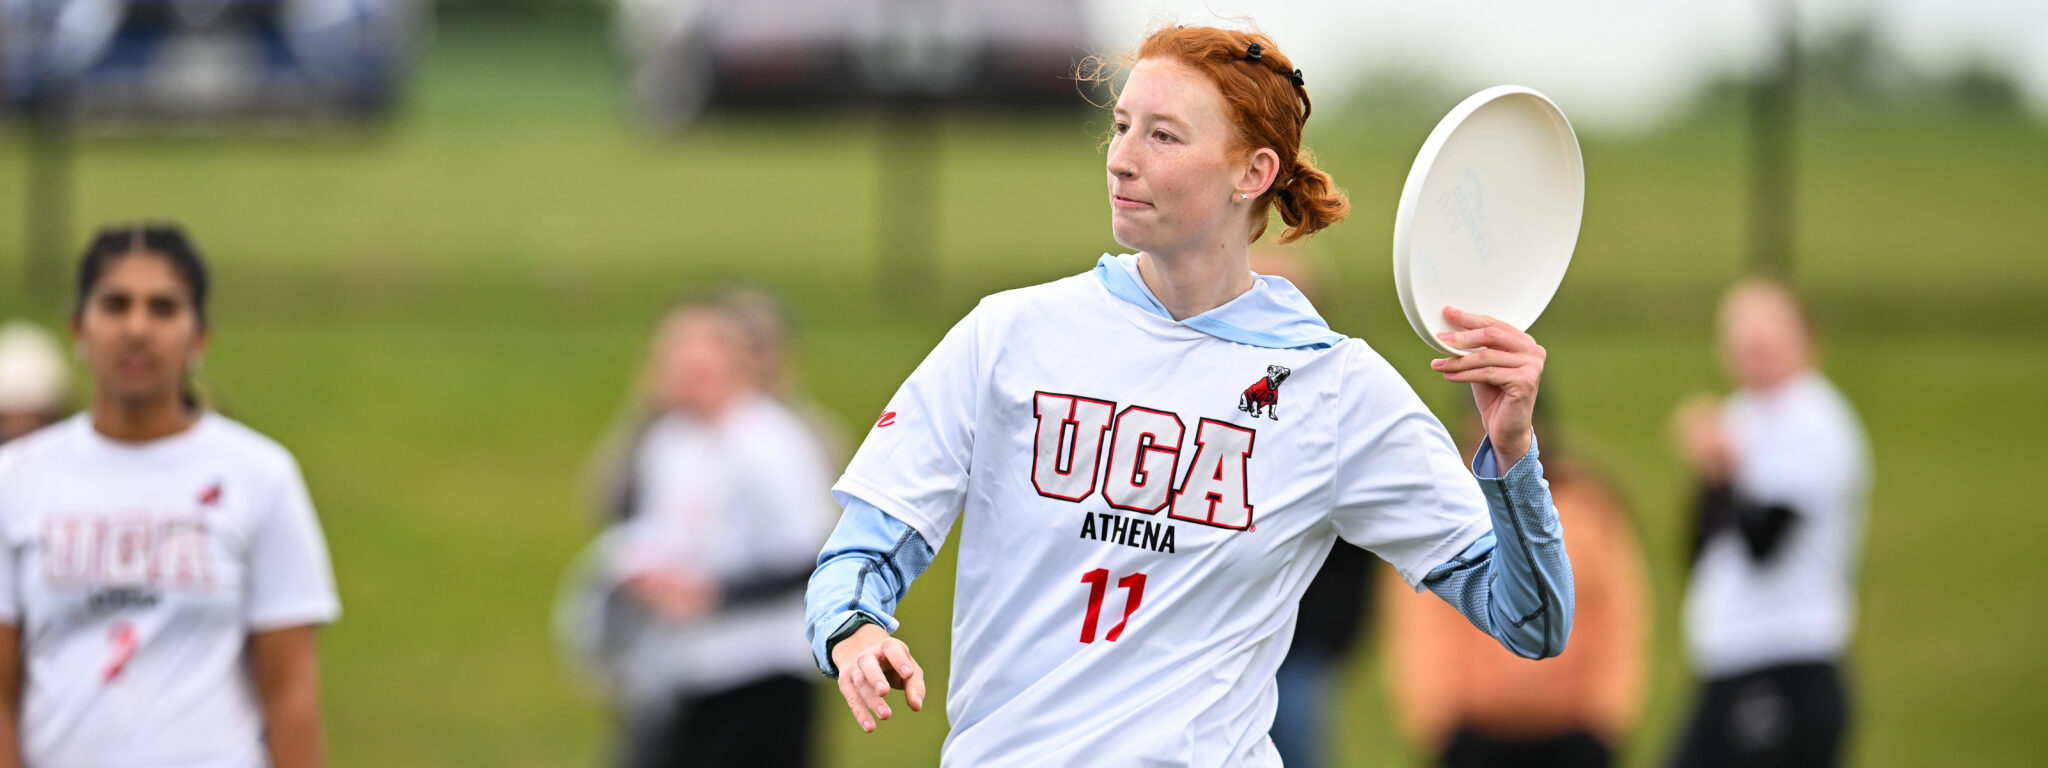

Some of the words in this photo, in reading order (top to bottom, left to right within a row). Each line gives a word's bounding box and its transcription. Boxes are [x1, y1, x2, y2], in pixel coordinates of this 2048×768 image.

[1031, 391, 1255, 531] UGA
[1080, 511, 1175, 553] ATHENA
[1079, 567, 1147, 643] 11
